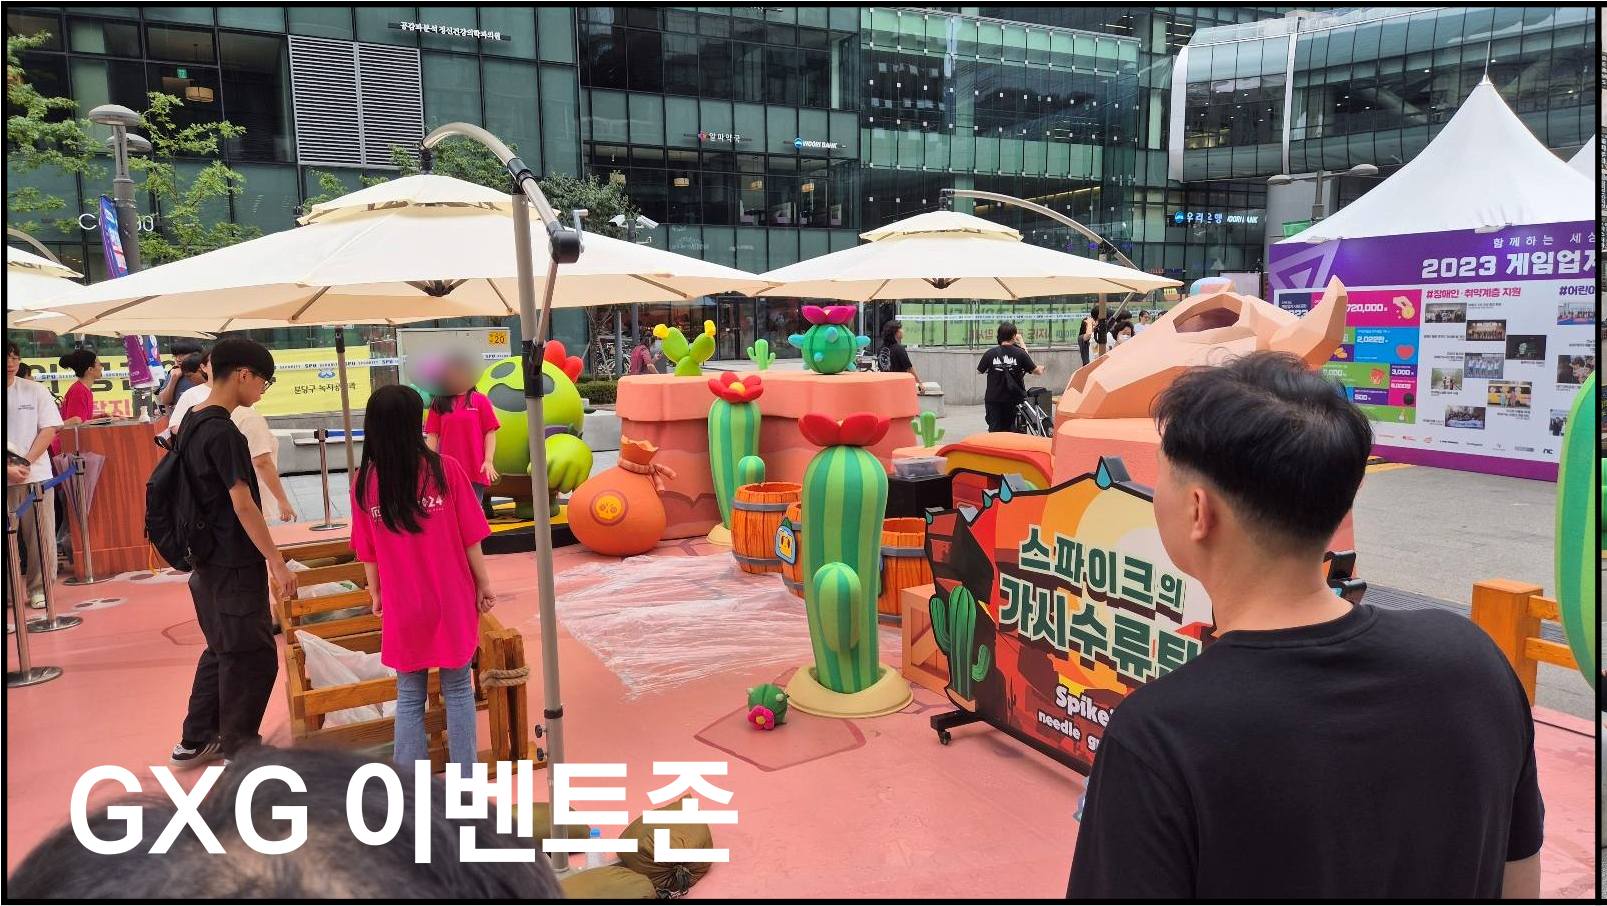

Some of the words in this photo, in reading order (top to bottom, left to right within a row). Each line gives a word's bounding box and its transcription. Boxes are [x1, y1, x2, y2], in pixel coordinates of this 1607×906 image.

[1187, 212, 1223, 224] 우리은행
[1421, 255, 1497, 279] 2023
[1019, 523, 1187, 612] 스파이크의
[1055, 684, 1114, 728] Spike'
[1038, 709, 1081, 741] needle
